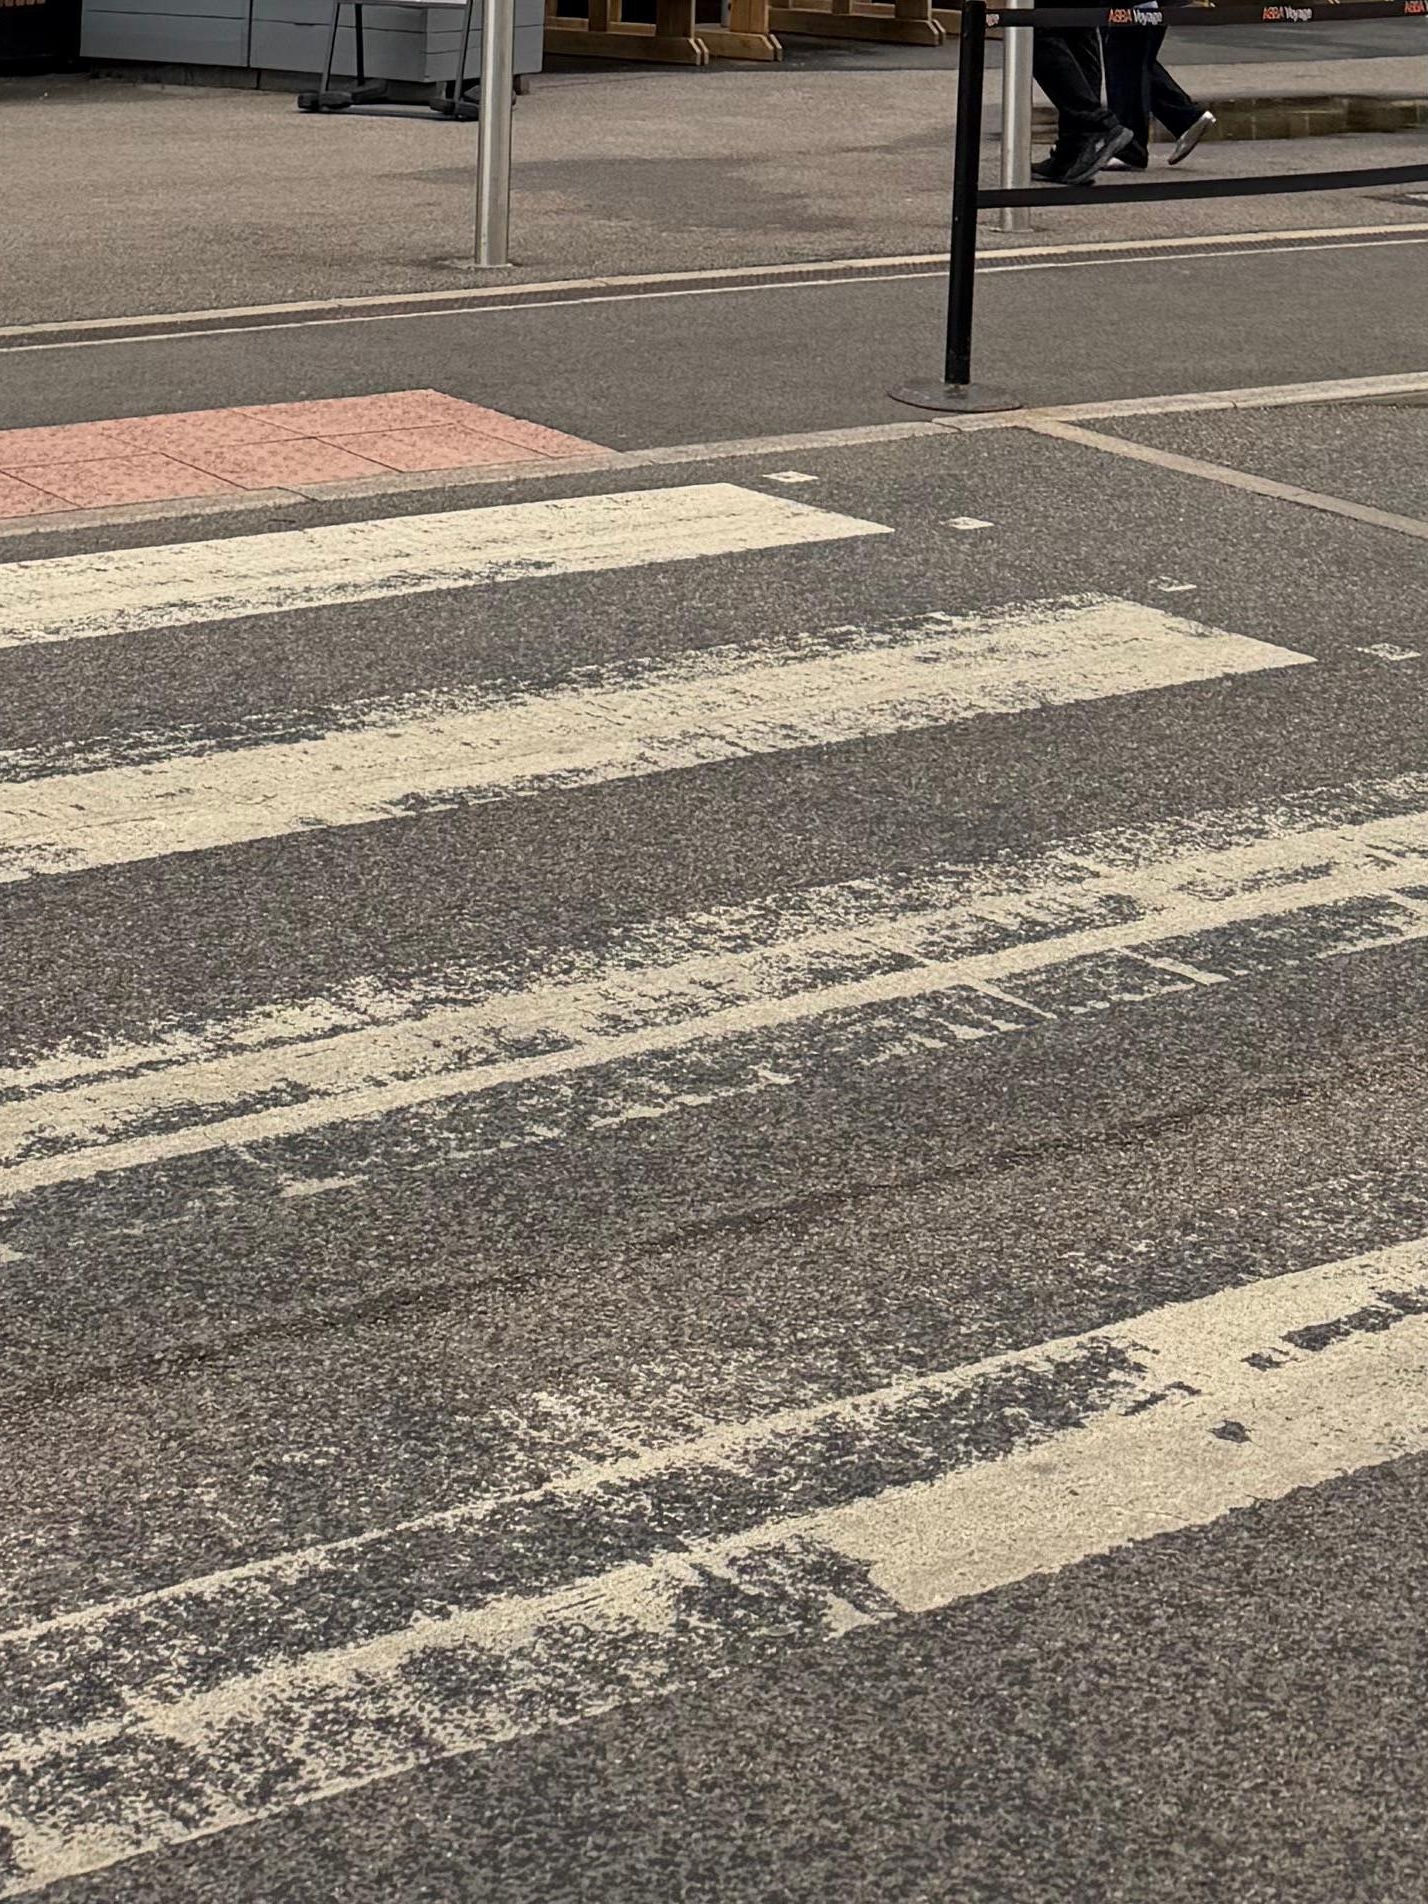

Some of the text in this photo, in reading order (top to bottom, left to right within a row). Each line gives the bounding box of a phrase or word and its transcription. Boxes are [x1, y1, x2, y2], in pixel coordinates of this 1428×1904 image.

[1108, 8, 1163, 26] ABBA Voyage
[1262, 6, 1285, 20] ABBA
